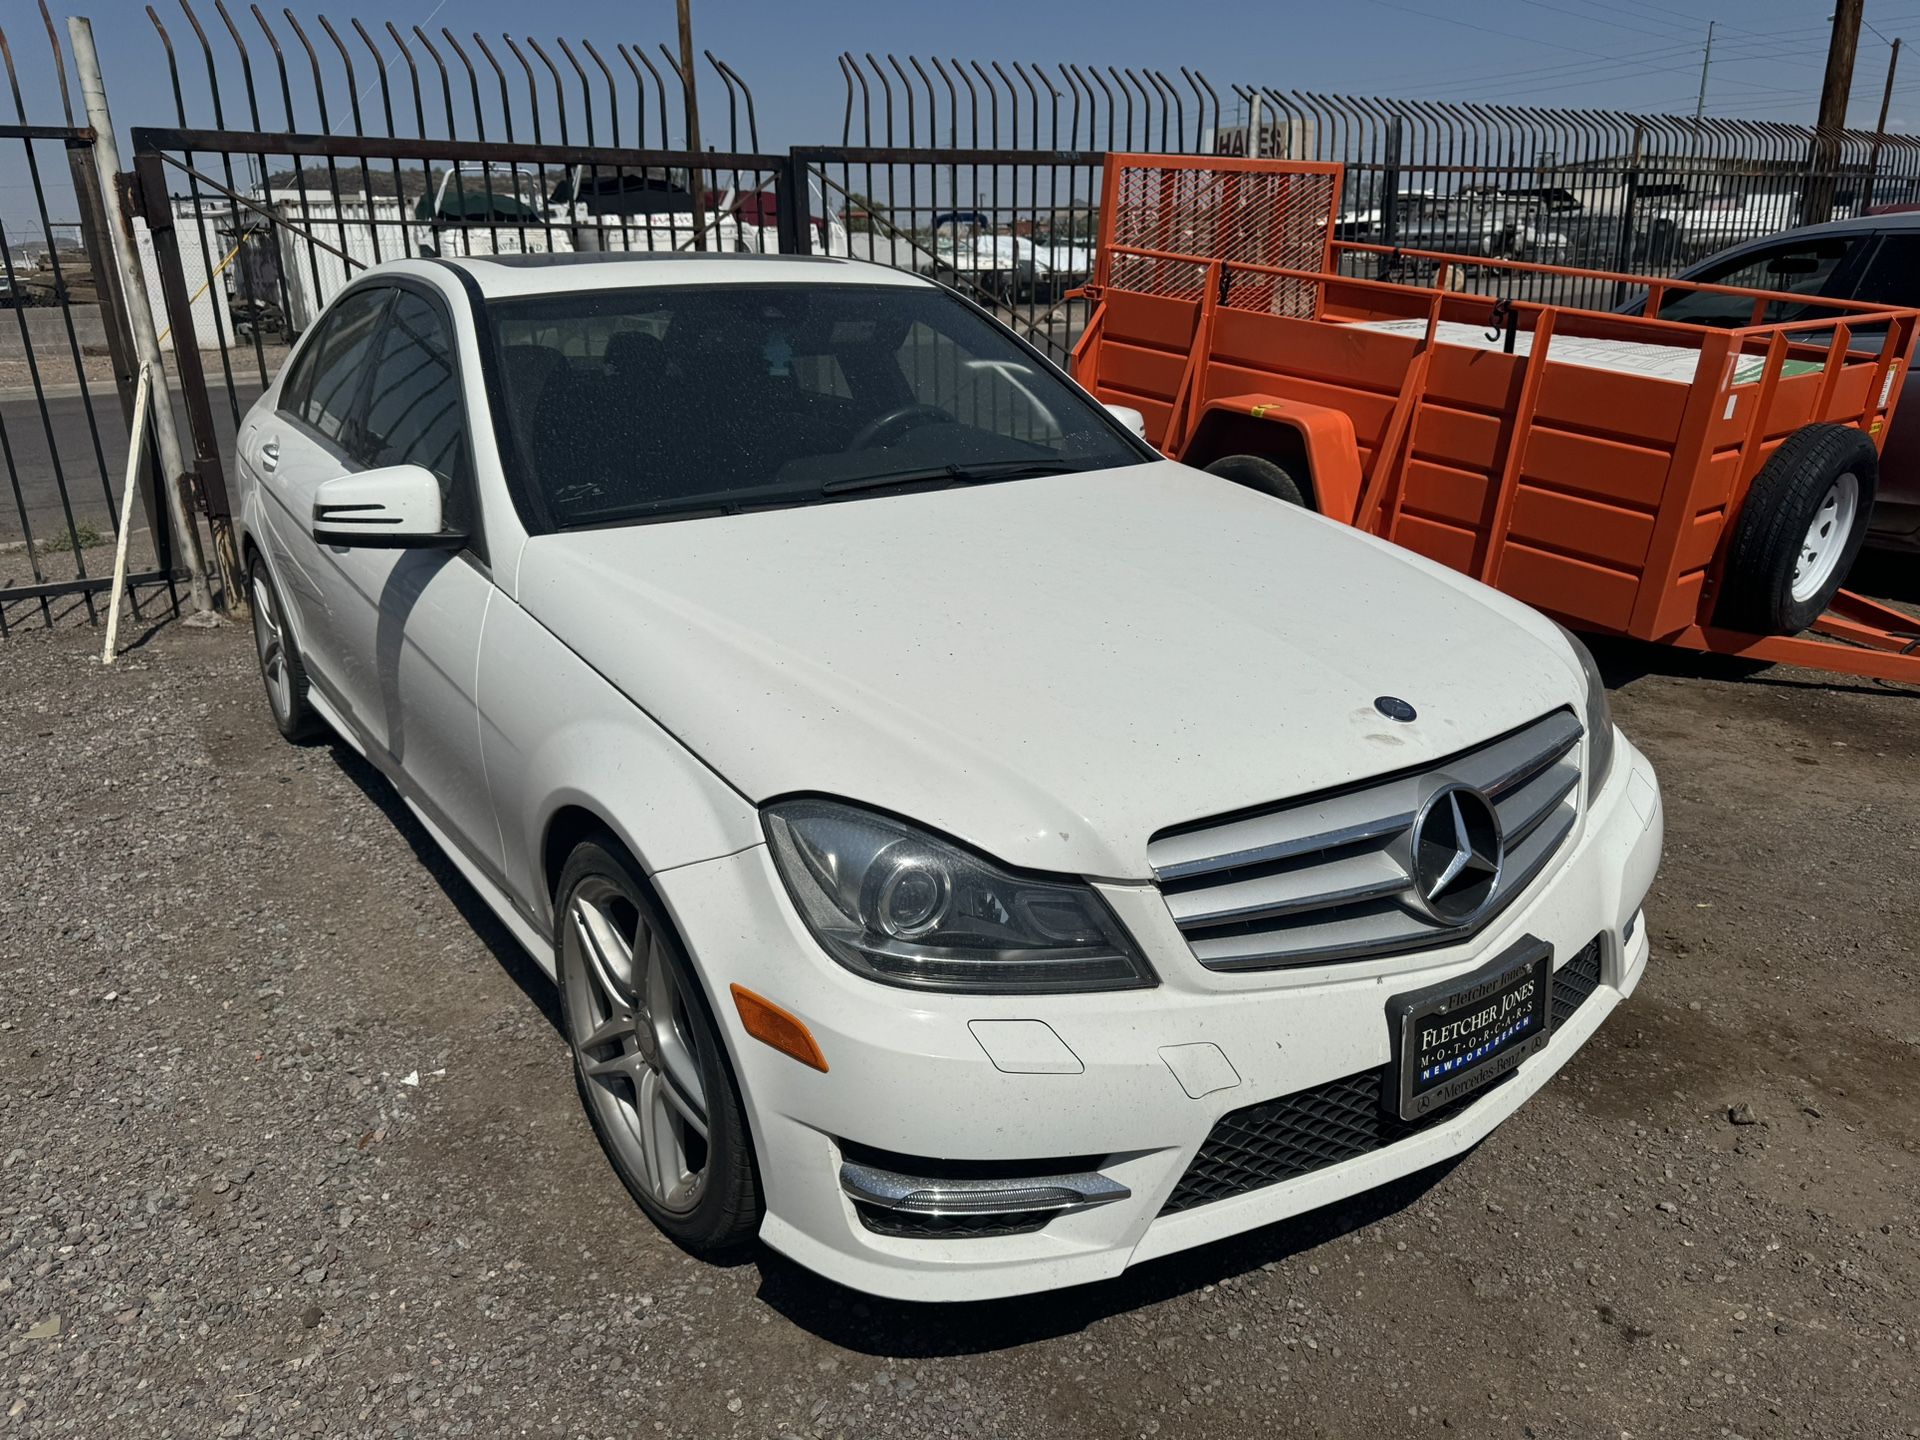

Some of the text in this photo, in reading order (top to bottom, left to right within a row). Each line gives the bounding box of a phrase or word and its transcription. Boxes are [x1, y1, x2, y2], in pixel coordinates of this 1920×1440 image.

[1219, 126, 1281, 157] HAES
[1448, 966, 1526, 1008] Fletcher Jones
[1422, 980, 1534, 1051] FLETCHER JONES
[1423, 1016, 1529, 1080] NEWPORT BEACH
[1443, 1052, 1521, 1101] Mercedes-Benz
